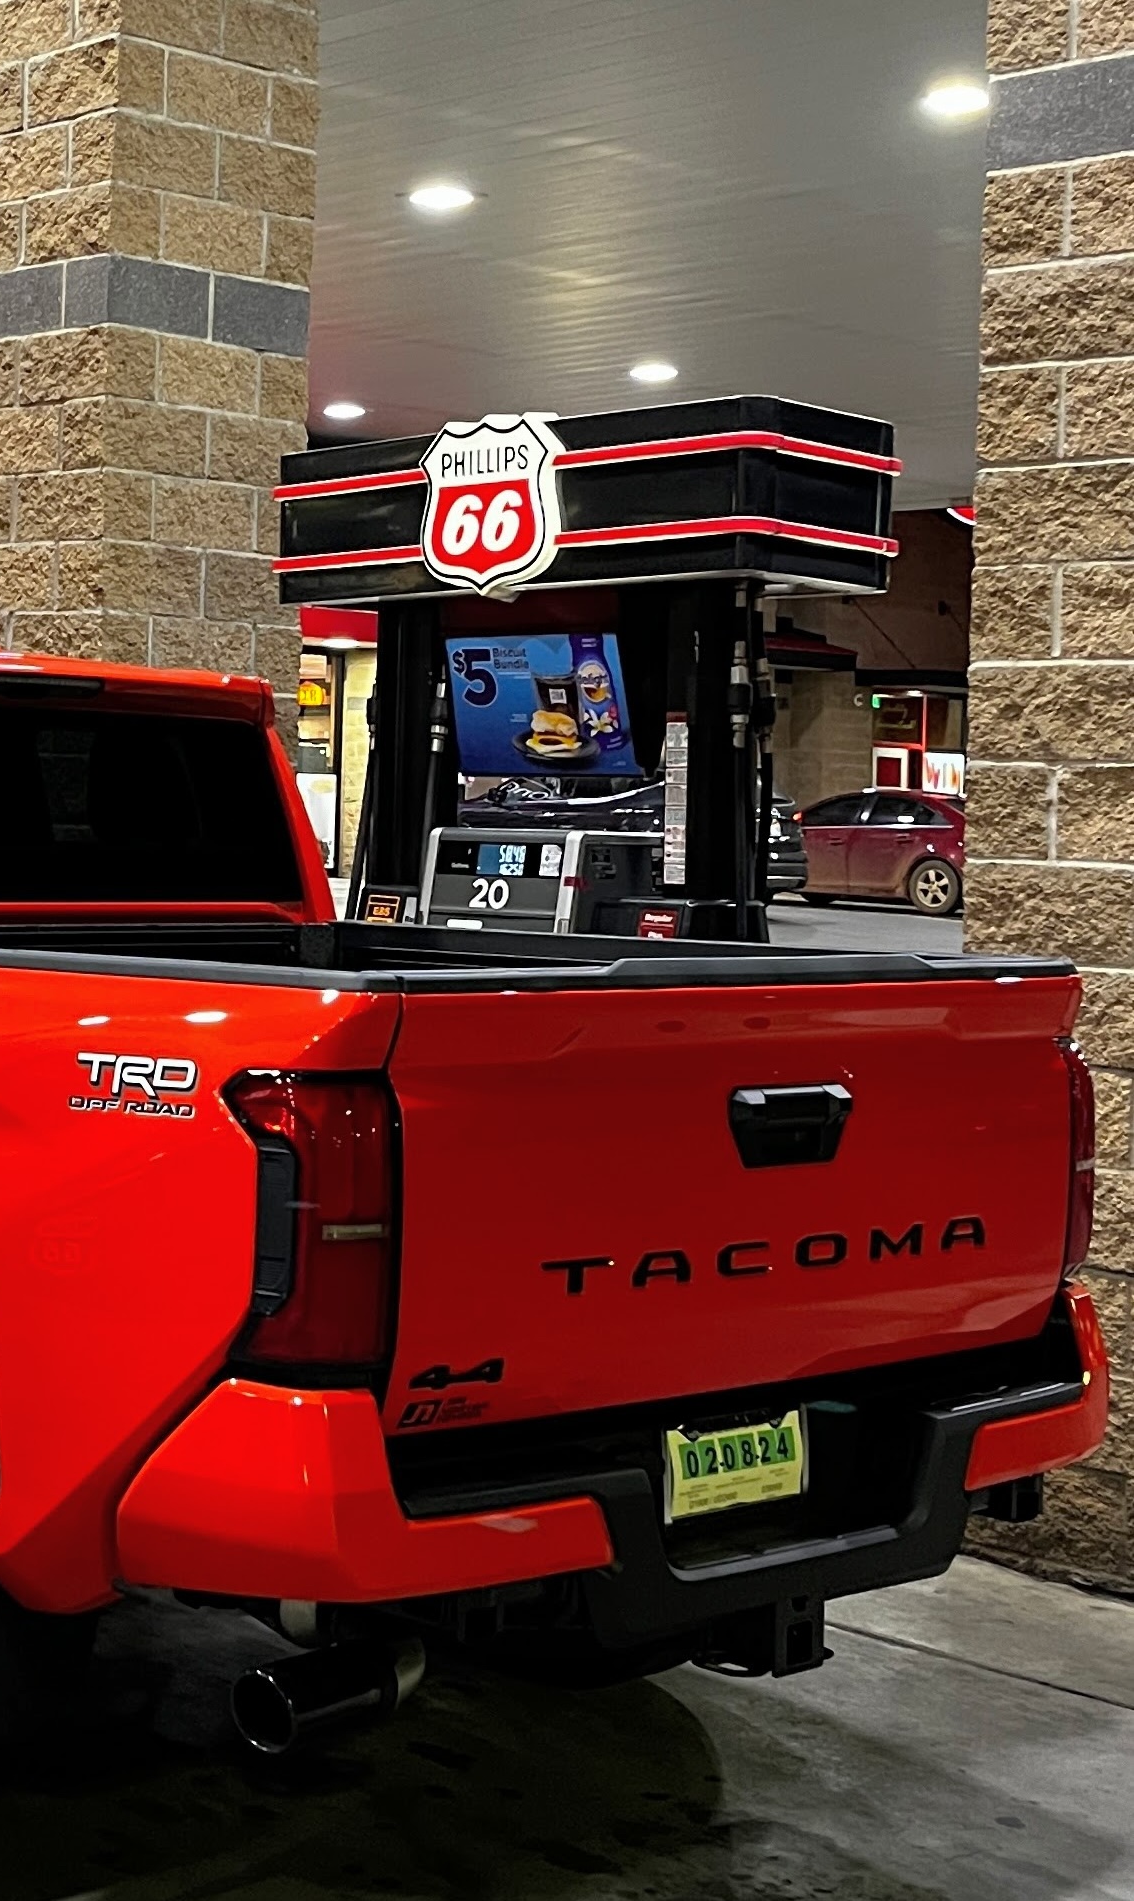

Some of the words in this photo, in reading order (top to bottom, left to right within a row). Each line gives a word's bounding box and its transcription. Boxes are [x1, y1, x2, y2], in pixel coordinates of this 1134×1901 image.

[441, 444, 529, 478] PHILLIPS
[441, 489, 523, 556] 66
[492, 647, 527, 658] Biscuit
[494, 658, 530, 670] Bundle
[452, 648, 498, 706] $5
[469, 878, 509, 909] 20
[77, 1052, 197, 1098] TRD
[69, 1096, 120, 1111] OFF
[124, 1100, 195, 1119] ROAD
[541, 1215, 985, 1295] TACOMA
